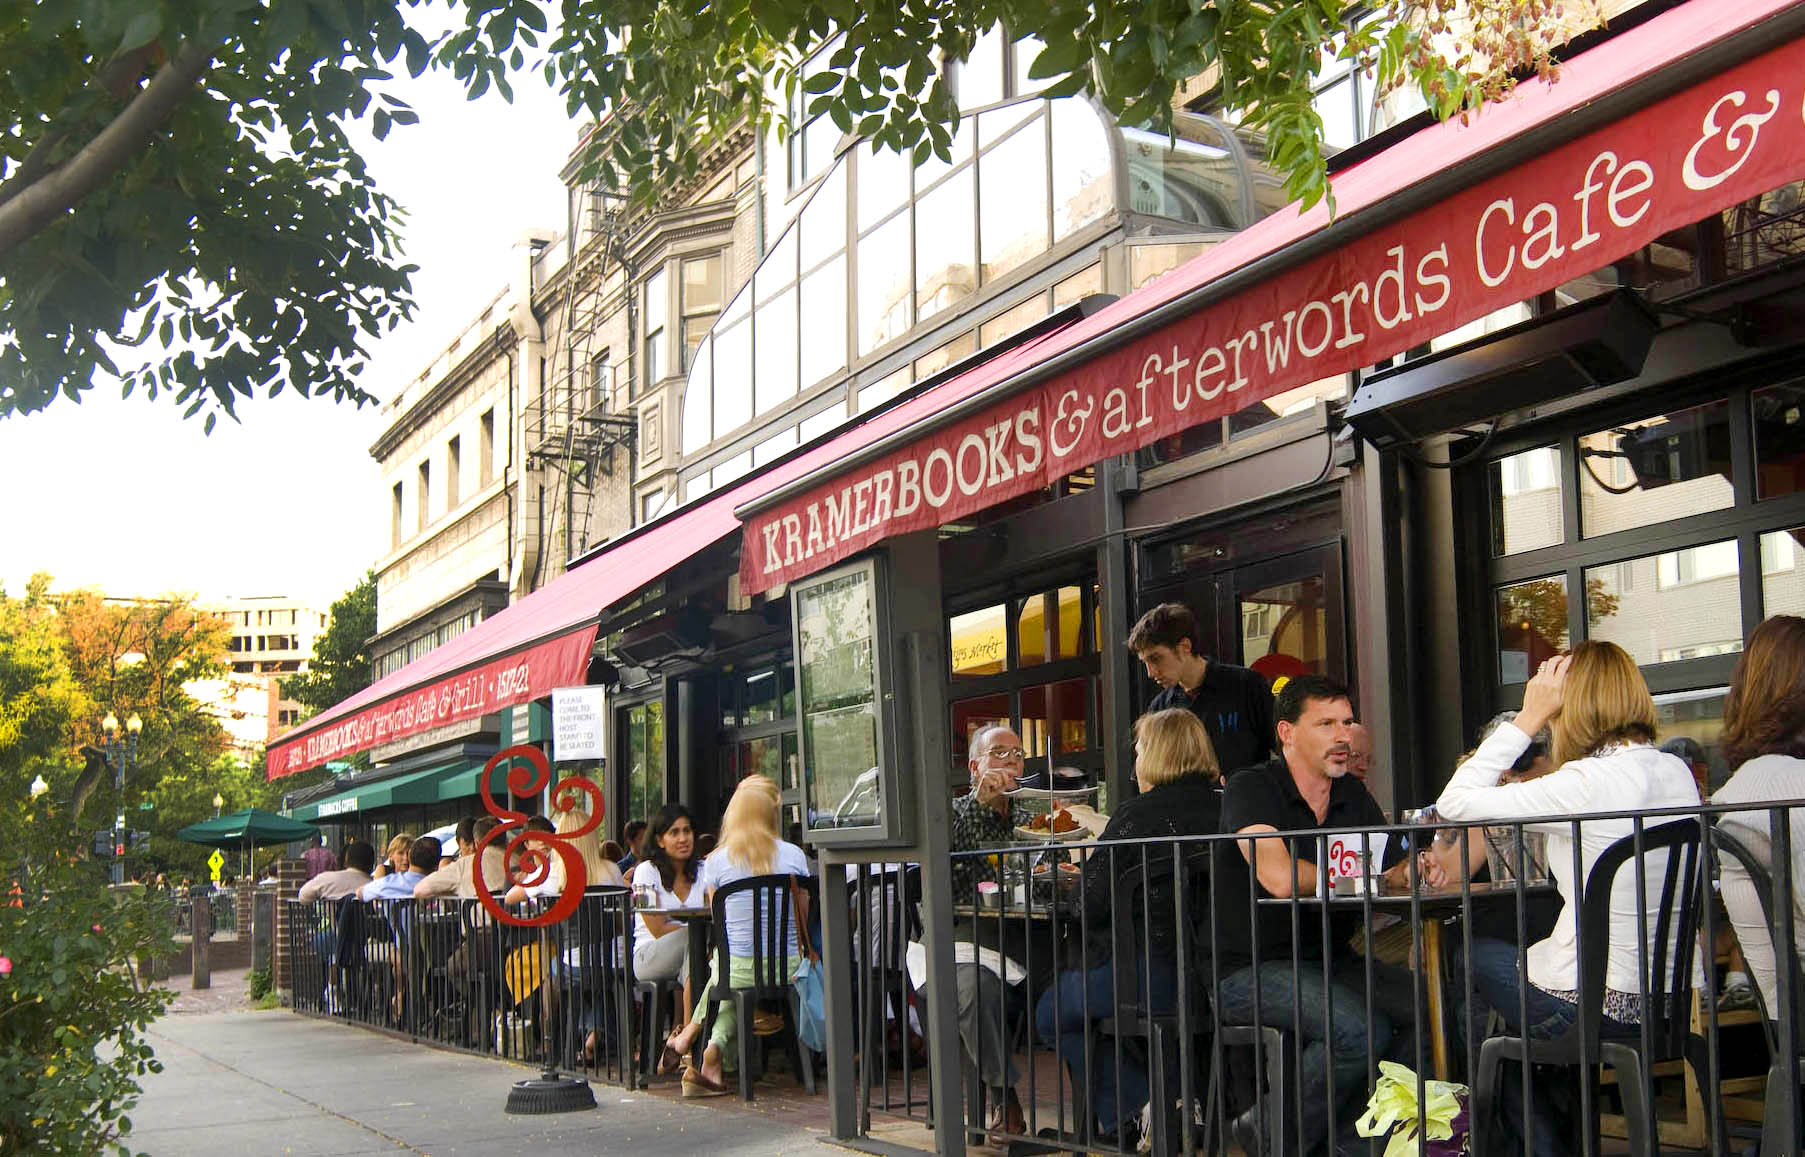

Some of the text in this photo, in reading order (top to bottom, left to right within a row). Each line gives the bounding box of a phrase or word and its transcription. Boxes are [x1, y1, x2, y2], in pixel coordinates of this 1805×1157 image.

[762, 88, 1781, 575] KRAMERBOOKS & afterwords Cafe &
[496, 663, 529, 701] 1517-21
